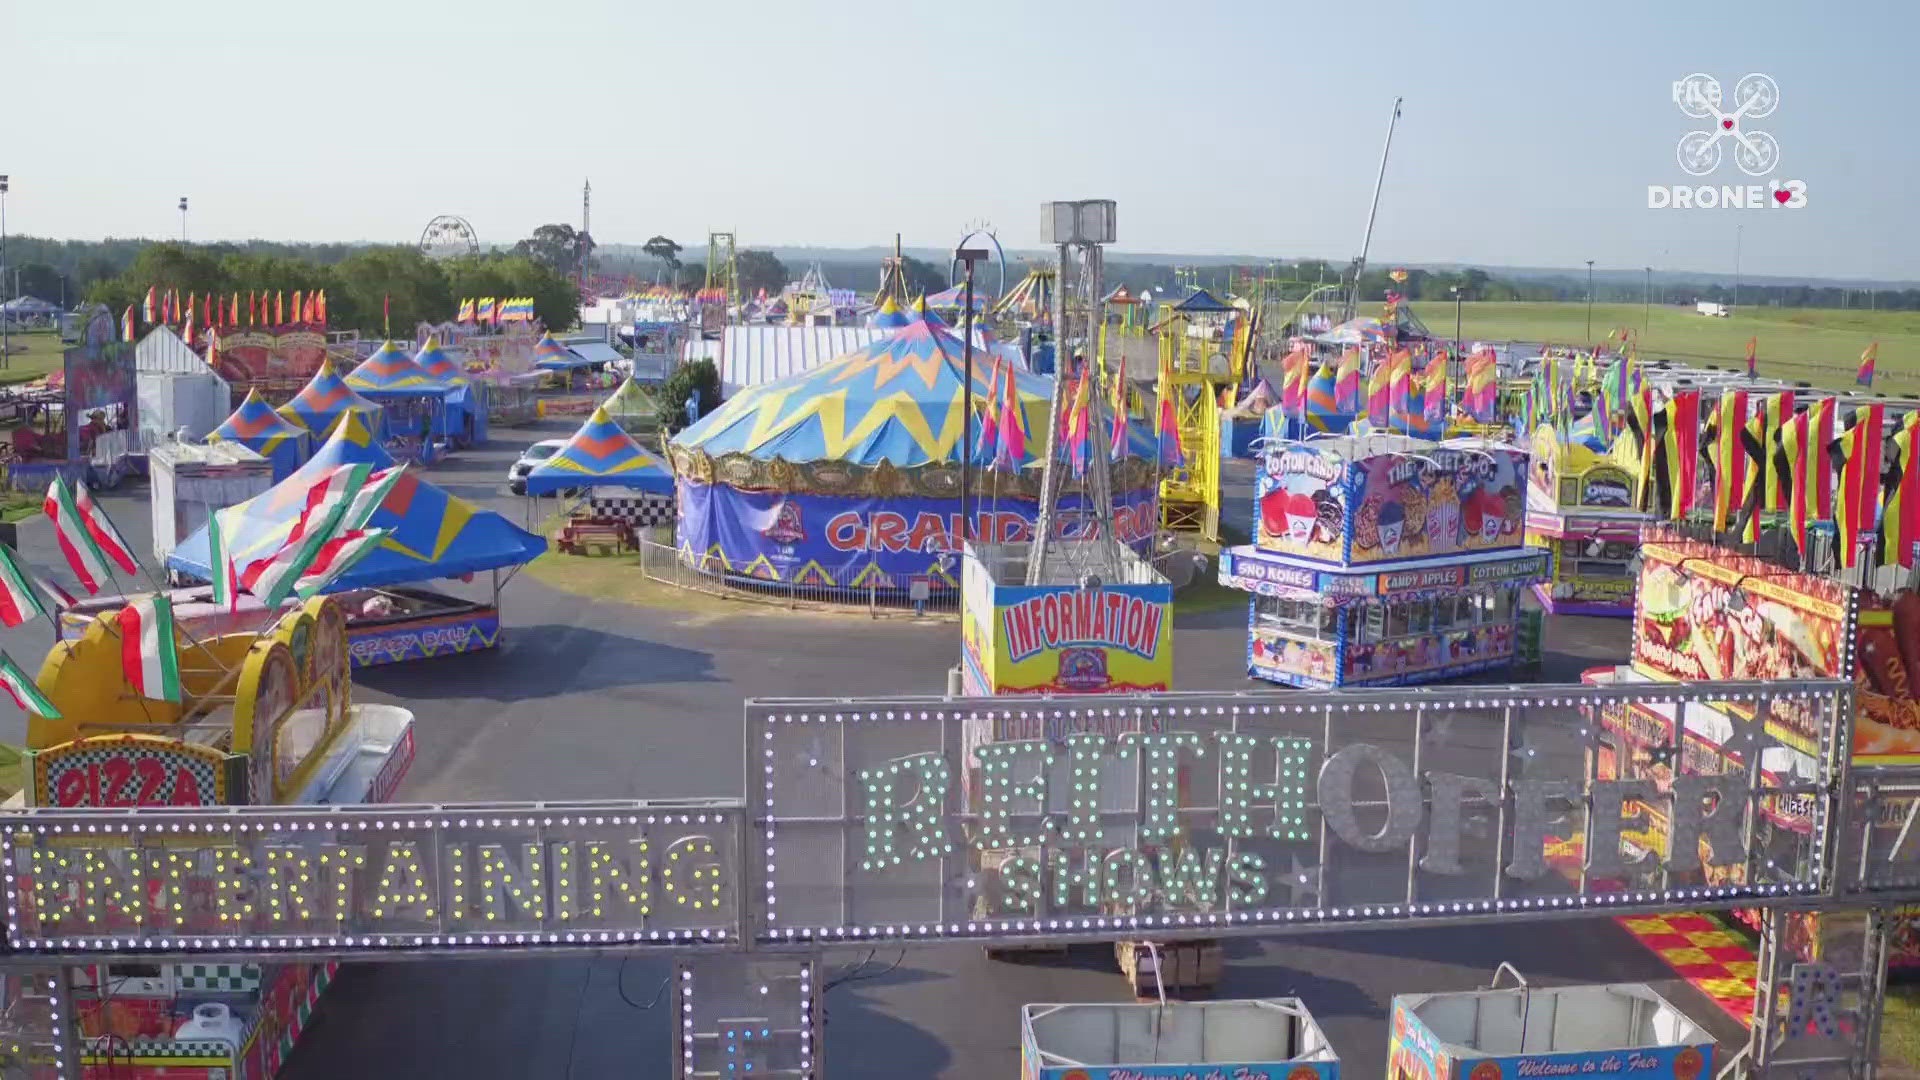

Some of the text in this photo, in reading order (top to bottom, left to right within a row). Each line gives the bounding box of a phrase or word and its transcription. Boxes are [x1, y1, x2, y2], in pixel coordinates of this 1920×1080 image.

[1266, 451, 1342, 481] COTTON CANDY
[1387, 462, 1413, 484] THE
[1463, 453, 1498, 481] SPO
[825, 511, 1031, 552] GRAND
[1238, 562, 1312, 587] SNO KONES
[1384, 571, 1457, 589] CANDY APPLES
[1473, 559, 1541, 579] COTTON CANDY
[351, 626, 470, 656] CRAZY BALL
[1003, 590, 1163, 663] INFORMATION
[58, 756, 201, 808] PIZZA
[856, 731, 1750, 880] REITHOFFER
[33, 837, 722, 922] ENTERTAINING
[1000, 847, 1268, 909] SHOWS
[1517, 1052, 1660, 1076] Welcome to the Fair
